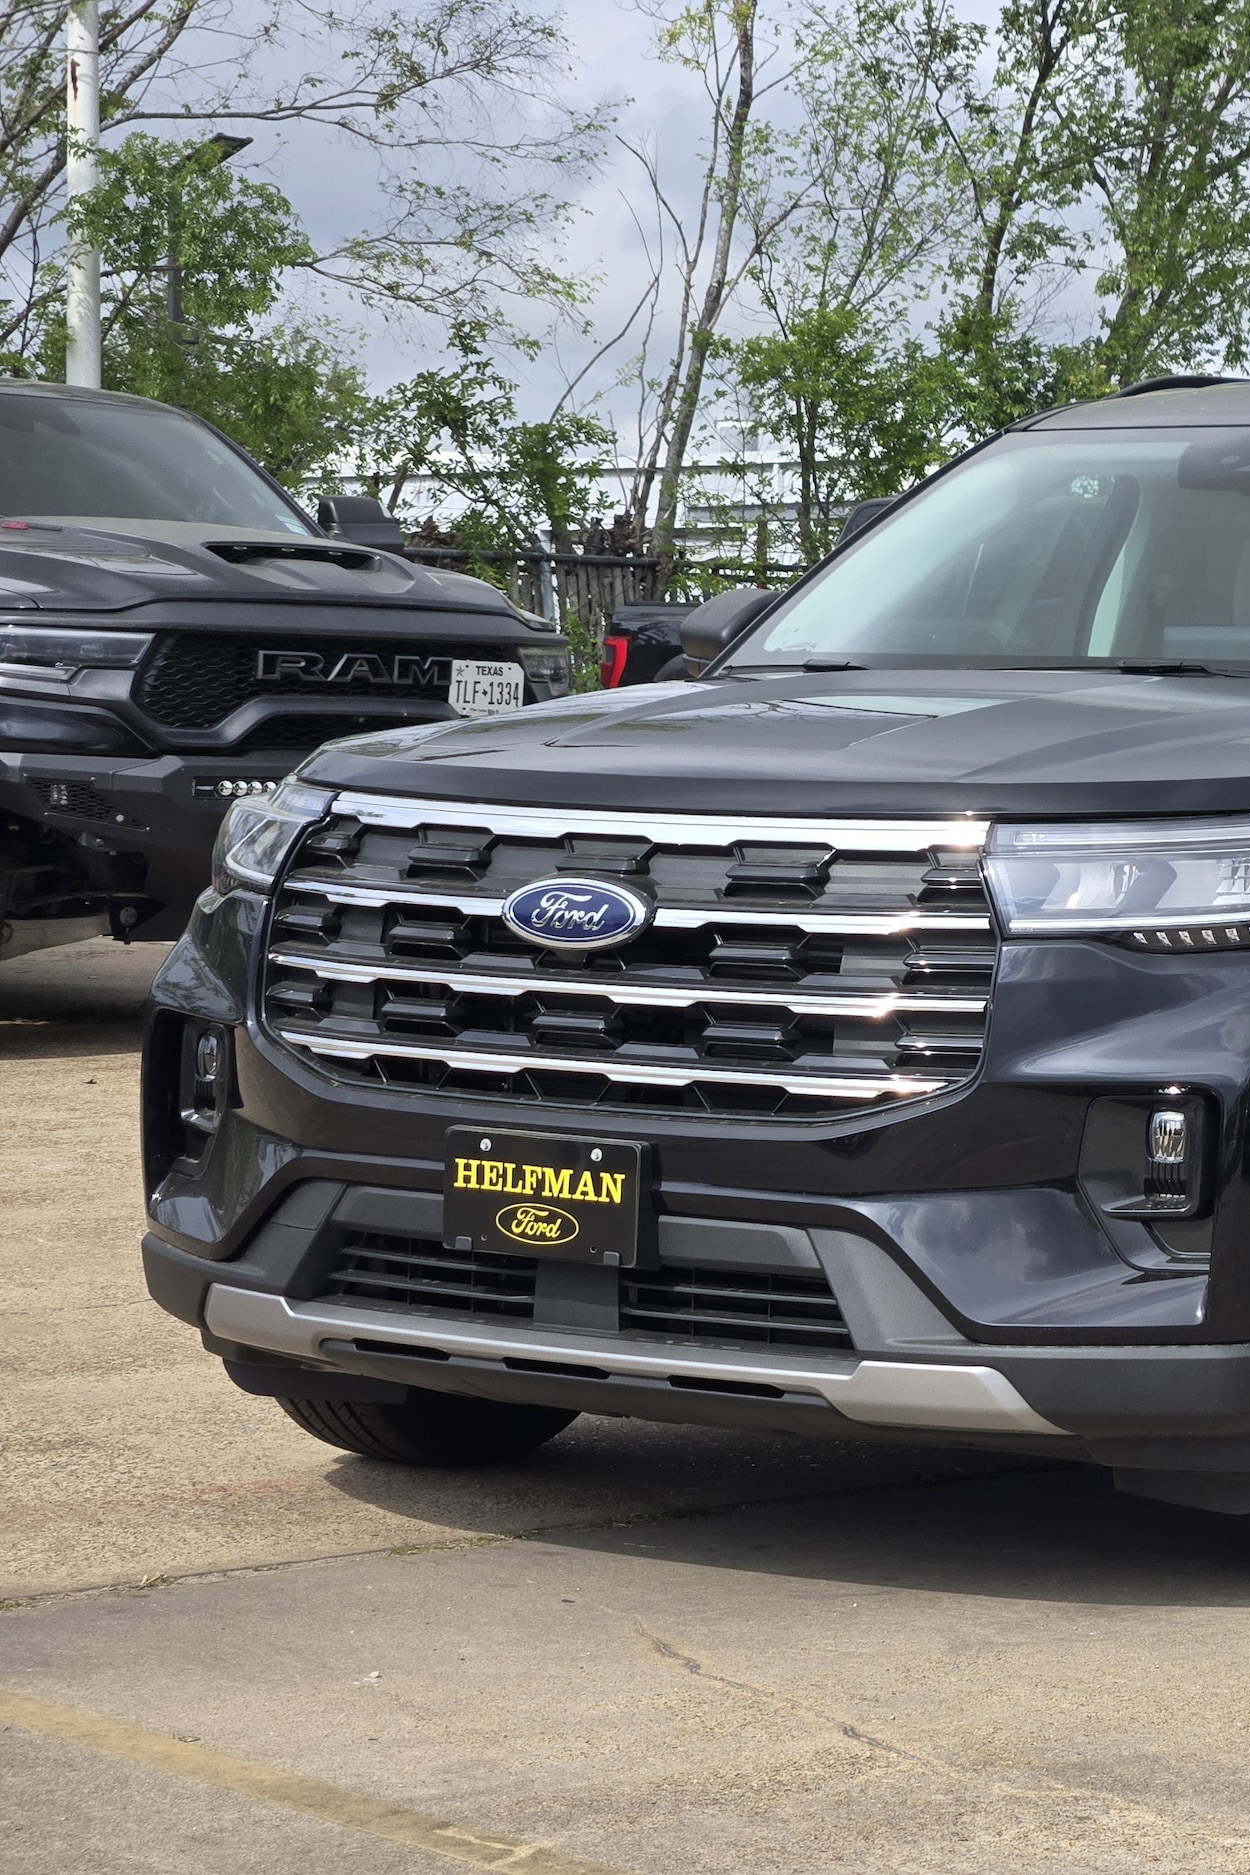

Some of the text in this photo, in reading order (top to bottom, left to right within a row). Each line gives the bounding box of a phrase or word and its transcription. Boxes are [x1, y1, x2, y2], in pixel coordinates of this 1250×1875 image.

[256, 650, 453, 686] RAM
[475, 664, 504, 677] TEXAS
[455, 679, 520, 709] TLF 1334
[531, 891, 610, 931] Ford
[453, 1158, 626, 1204] HELFMAN
[511, 1207, 562, 1238] Ford
